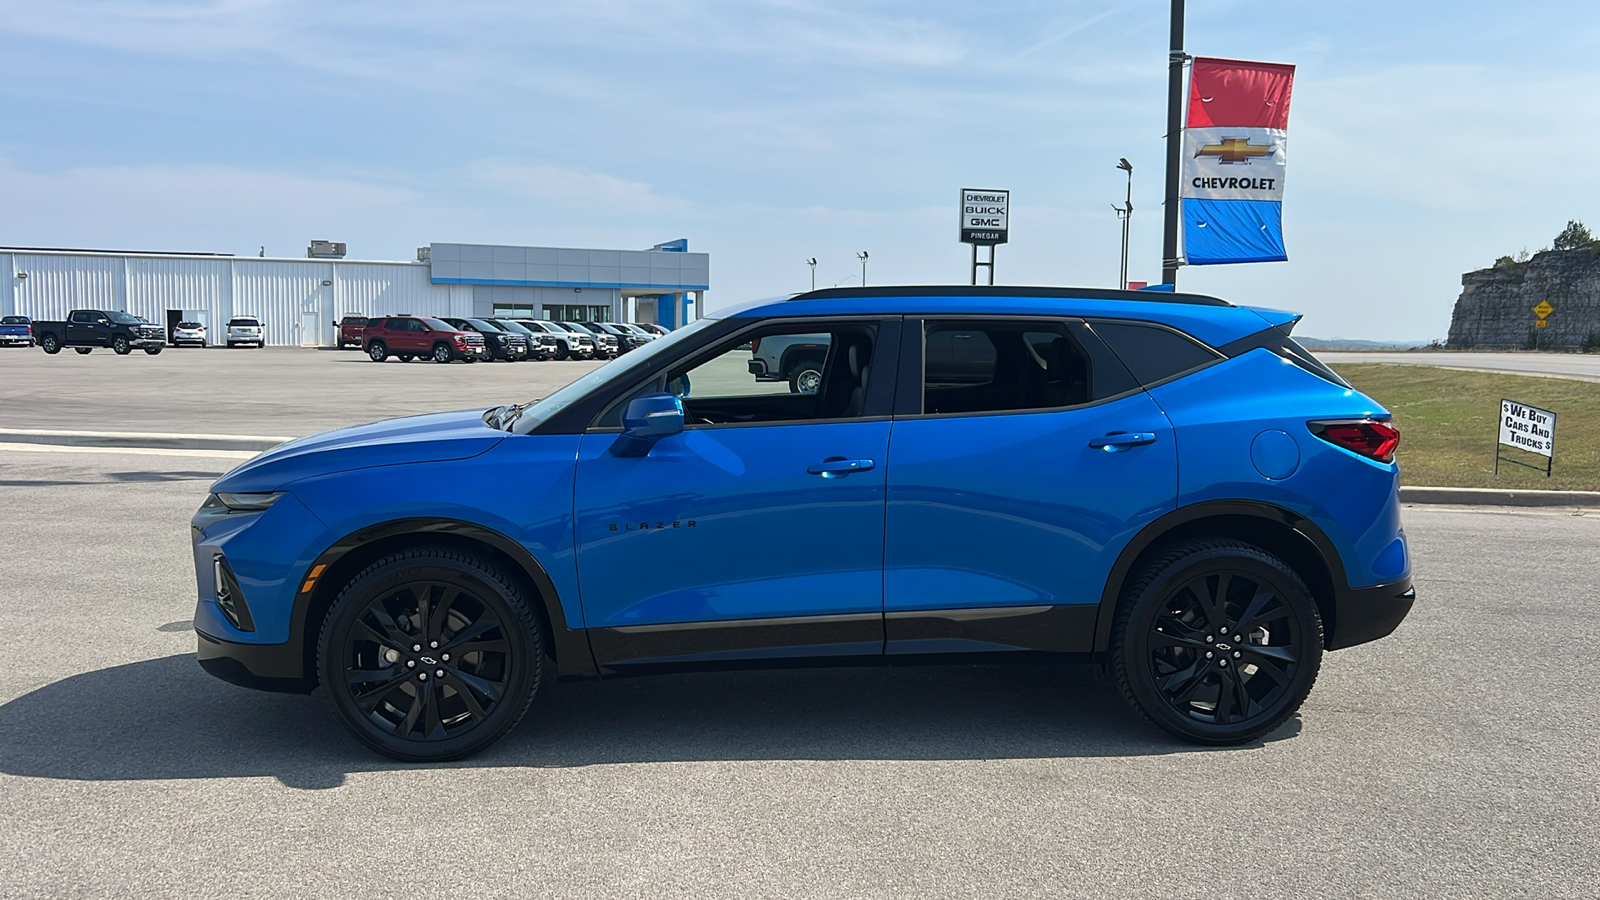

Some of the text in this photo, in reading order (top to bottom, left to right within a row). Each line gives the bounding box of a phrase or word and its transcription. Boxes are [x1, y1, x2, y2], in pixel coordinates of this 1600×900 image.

[966, 194, 1005, 202] CHEVROLET
[965, 206, 1005, 214] BUICK
[970, 218, 1000, 226] GMC
[609, 520, 697, 531] BLAZER
